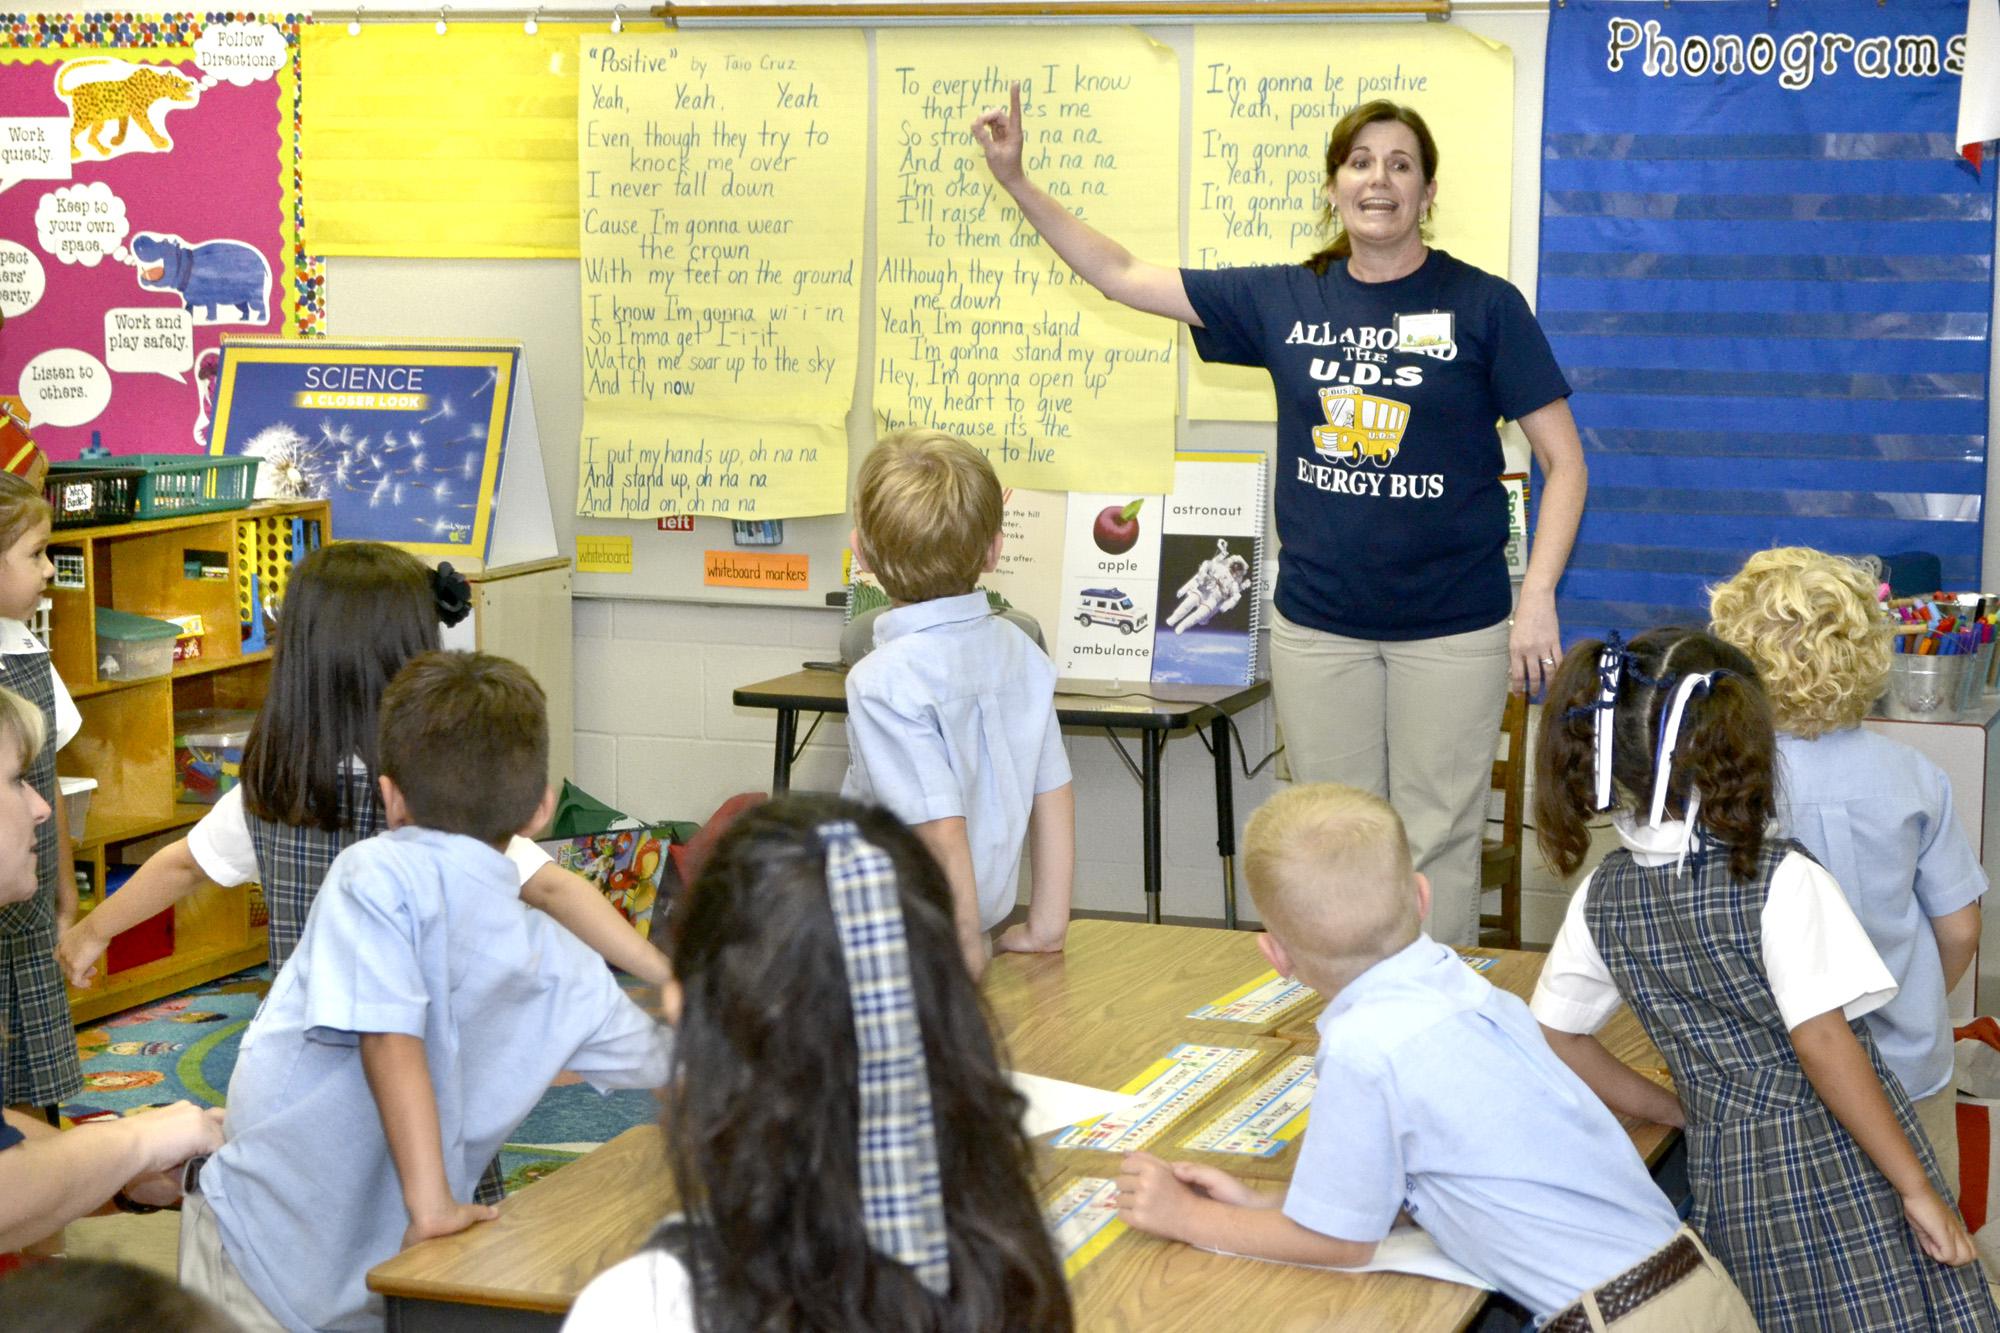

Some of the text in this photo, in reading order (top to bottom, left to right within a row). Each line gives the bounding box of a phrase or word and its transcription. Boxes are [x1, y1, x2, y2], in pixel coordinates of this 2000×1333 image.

[218, 32, 264, 47] Follow
[691, 56, 707, 78] by
[760, 55, 796, 70] Cruz
[777, 82, 819, 108] Yeah
[895, 65, 1131, 106] To everythig I know
[1207, 63, 1428, 104] I'm gonna be positive
[1060, 104, 1091, 118] me
[9, 127, 45, 142] Work
[588, 120, 829, 158] Even though they try to
[898, 121, 921, 146] So
[1040, 128, 1063, 143] na
[1073, 128, 1102, 144] na
[631, 147, 796, 172] knock me over
[900, 147, 941, 172] And
[1203, 129, 1238, 158] I'm
[1254, 143, 1310, 167] gonna
[587, 170, 775, 198] I never fall down
[898, 173, 933, 198] I'm
[56, 199, 108, 216] Keep to
[897, 199, 985, 223] I'll raise
[1200, 183, 1233, 210] I'm
[1249, 196, 1302, 219] gonna
[49, 220, 115, 234] your own
[650, 209, 678, 234] I'm
[686, 219, 738, 245] gonna
[748, 218, 792, 233] wear
[927, 224, 1000, 247] to them
[639, 235, 749, 259] the crown
[585, 258, 853, 295] With my feet on the ground
[878, 257, 957, 295] Although
[969, 259, 1003, 295] they
[1014, 260, 1039, 295] try
[1048, 260, 1063, 285] to
[915, 284, 1000, 310] me down
[115, 314, 181, 329] Work and
[589, 295, 602, 322] I
[613, 296, 655, 321] know
[664, 295, 692, 321] I'm
[704, 308, 755, 332] gonna
[934, 307, 961, 334] I'm
[972, 320, 1024, 345] gonna
[110, 334, 188, 351] play safely.
[589, 322, 611, 344] So
[677, 322, 702, 353] get
[1286, 321, 1337, 345] ALL
[586, 346, 836, 384] Watch me soar up to the sky
[911, 336, 1172, 375] I'm gonna stand my ground
[1343, 346, 1387, 363] THE
[32, 366, 93, 380] Listen to
[305, 367, 424, 390] SCIENCE
[589, 369, 695, 400] And fly now
[928, 360, 959, 385] I'm
[968, 375, 1019, 396] gonna
[1030, 375, 1073, 397] open
[1085, 374, 1106, 399] up
[1309, 358, 1423, 386] U.D.S
[40, 386, 87, 400] others.
[303, 395, 419, 408] A CLOSER LOOK
[909, 386, 1072, 425] my heart to give
[1042, 415, 1071, 437] the
[584, 437, 599, 464] I
[664, 439, 712, 463] hands
[750, 439, 767, 461] oh
[1001, 438, 1055, 463] to live
[584, 464, 712, 487] And stand oh
[1297, 457, 1443, 498] ENERGY BUS
[581, 487, 704, 512] And hold oh
[1173, 505, 1242, 516] astronaut
[662, 515, 690, 529] left
[579, 549, 629, 564] whiteboard
[1098, 560, 1138, 574] apple
[707, 561, 807, 581] whiteboard markers
[1073, 644, 1149, 657] ambulance
